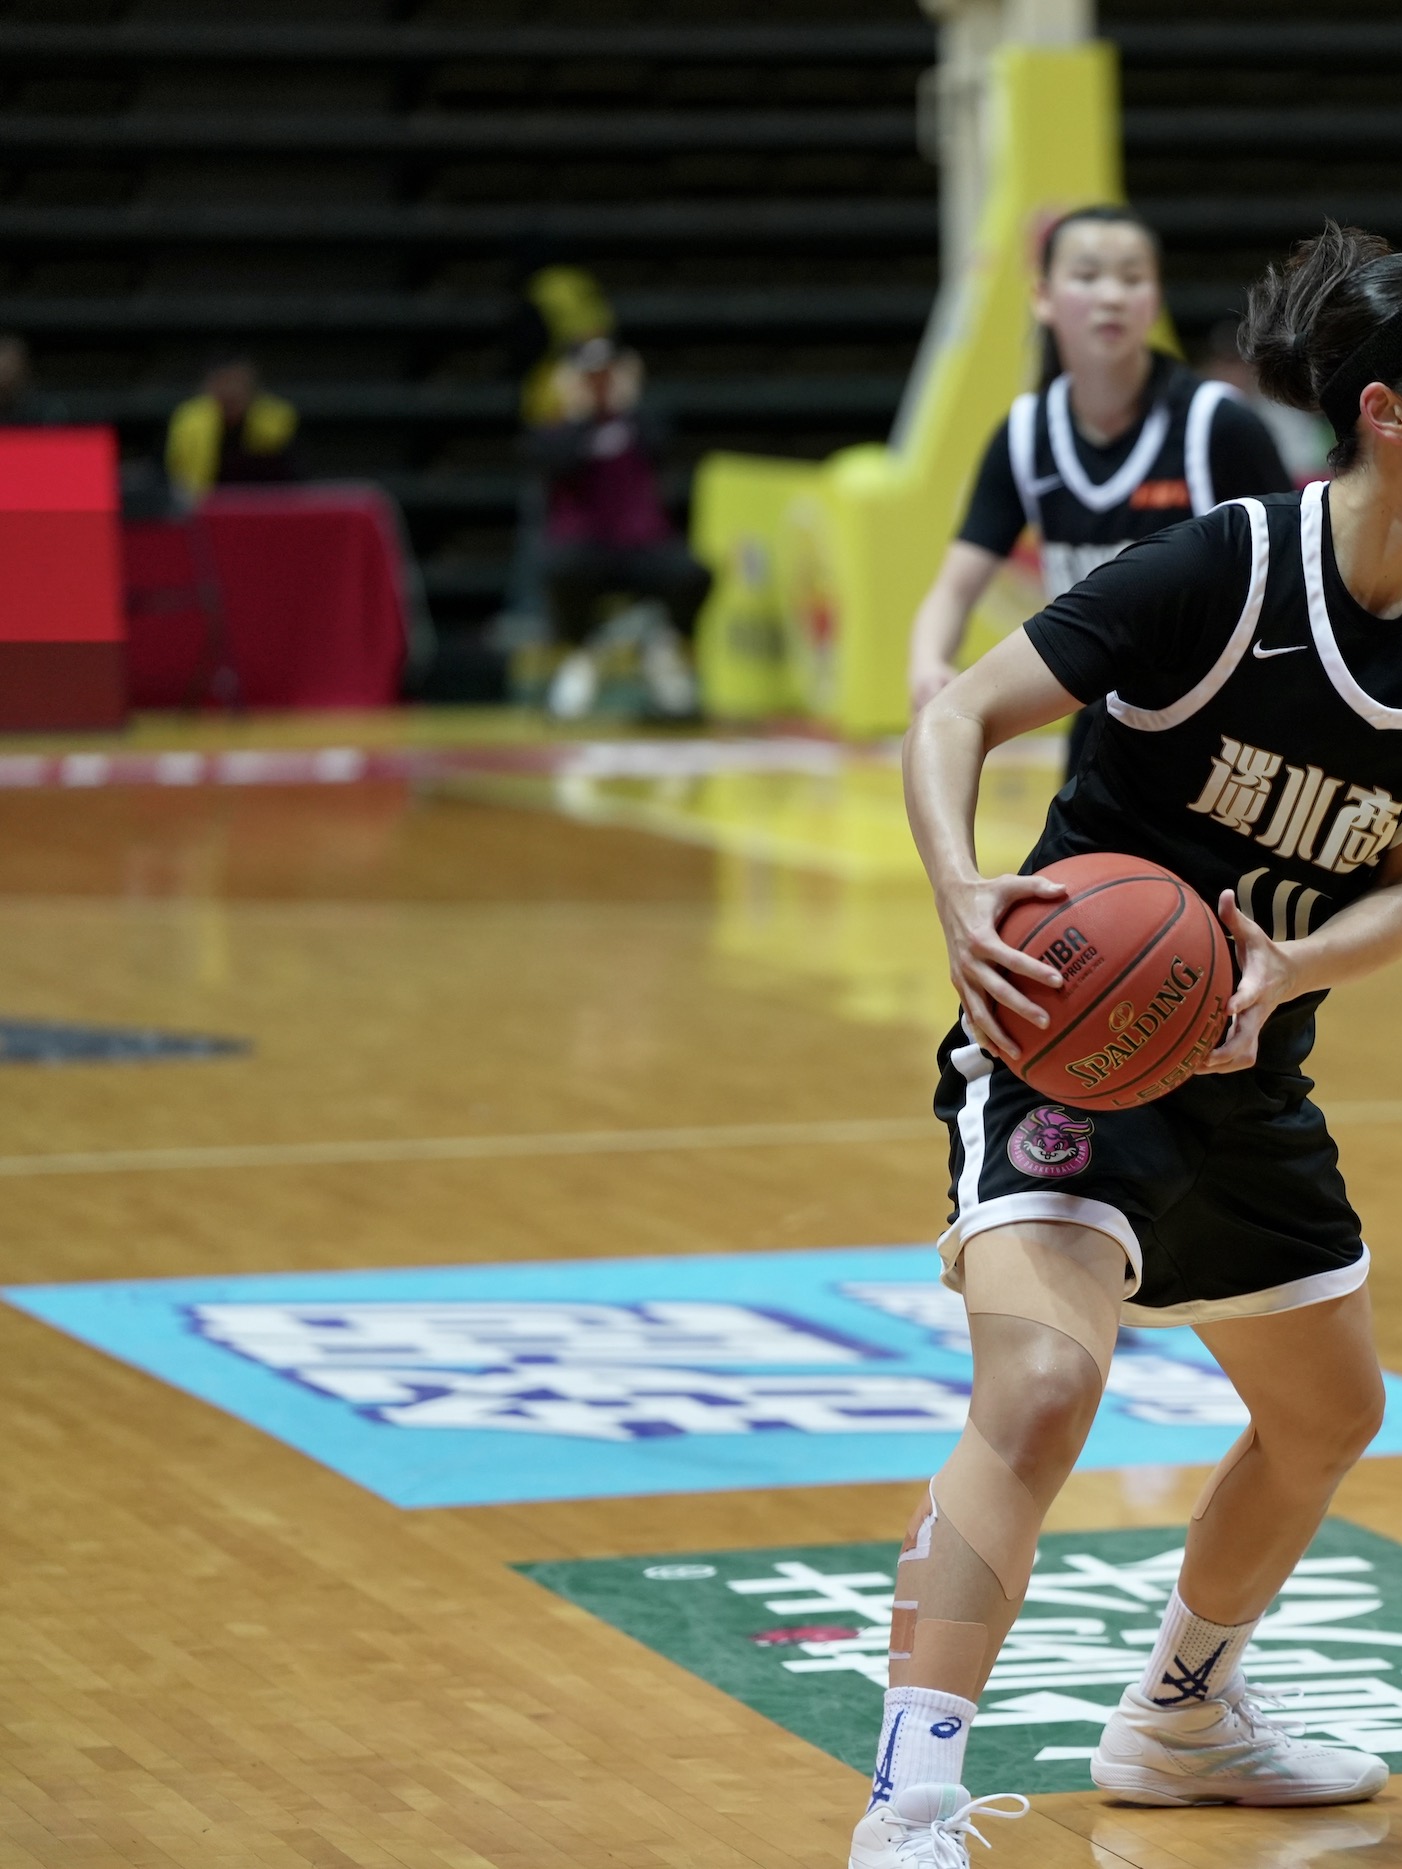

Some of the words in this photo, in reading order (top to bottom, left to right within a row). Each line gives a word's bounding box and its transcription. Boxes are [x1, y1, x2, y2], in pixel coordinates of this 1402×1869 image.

[1037, 927, 1089, 971] IBA
[1061, 946, 1098, 983] PROVED
[1065, 955, 1200, 1089] SPALDING
[1023, 1161, 1077, 1174] BASKETBALL
[1074, 1144, 1087, 1164] TEAM
